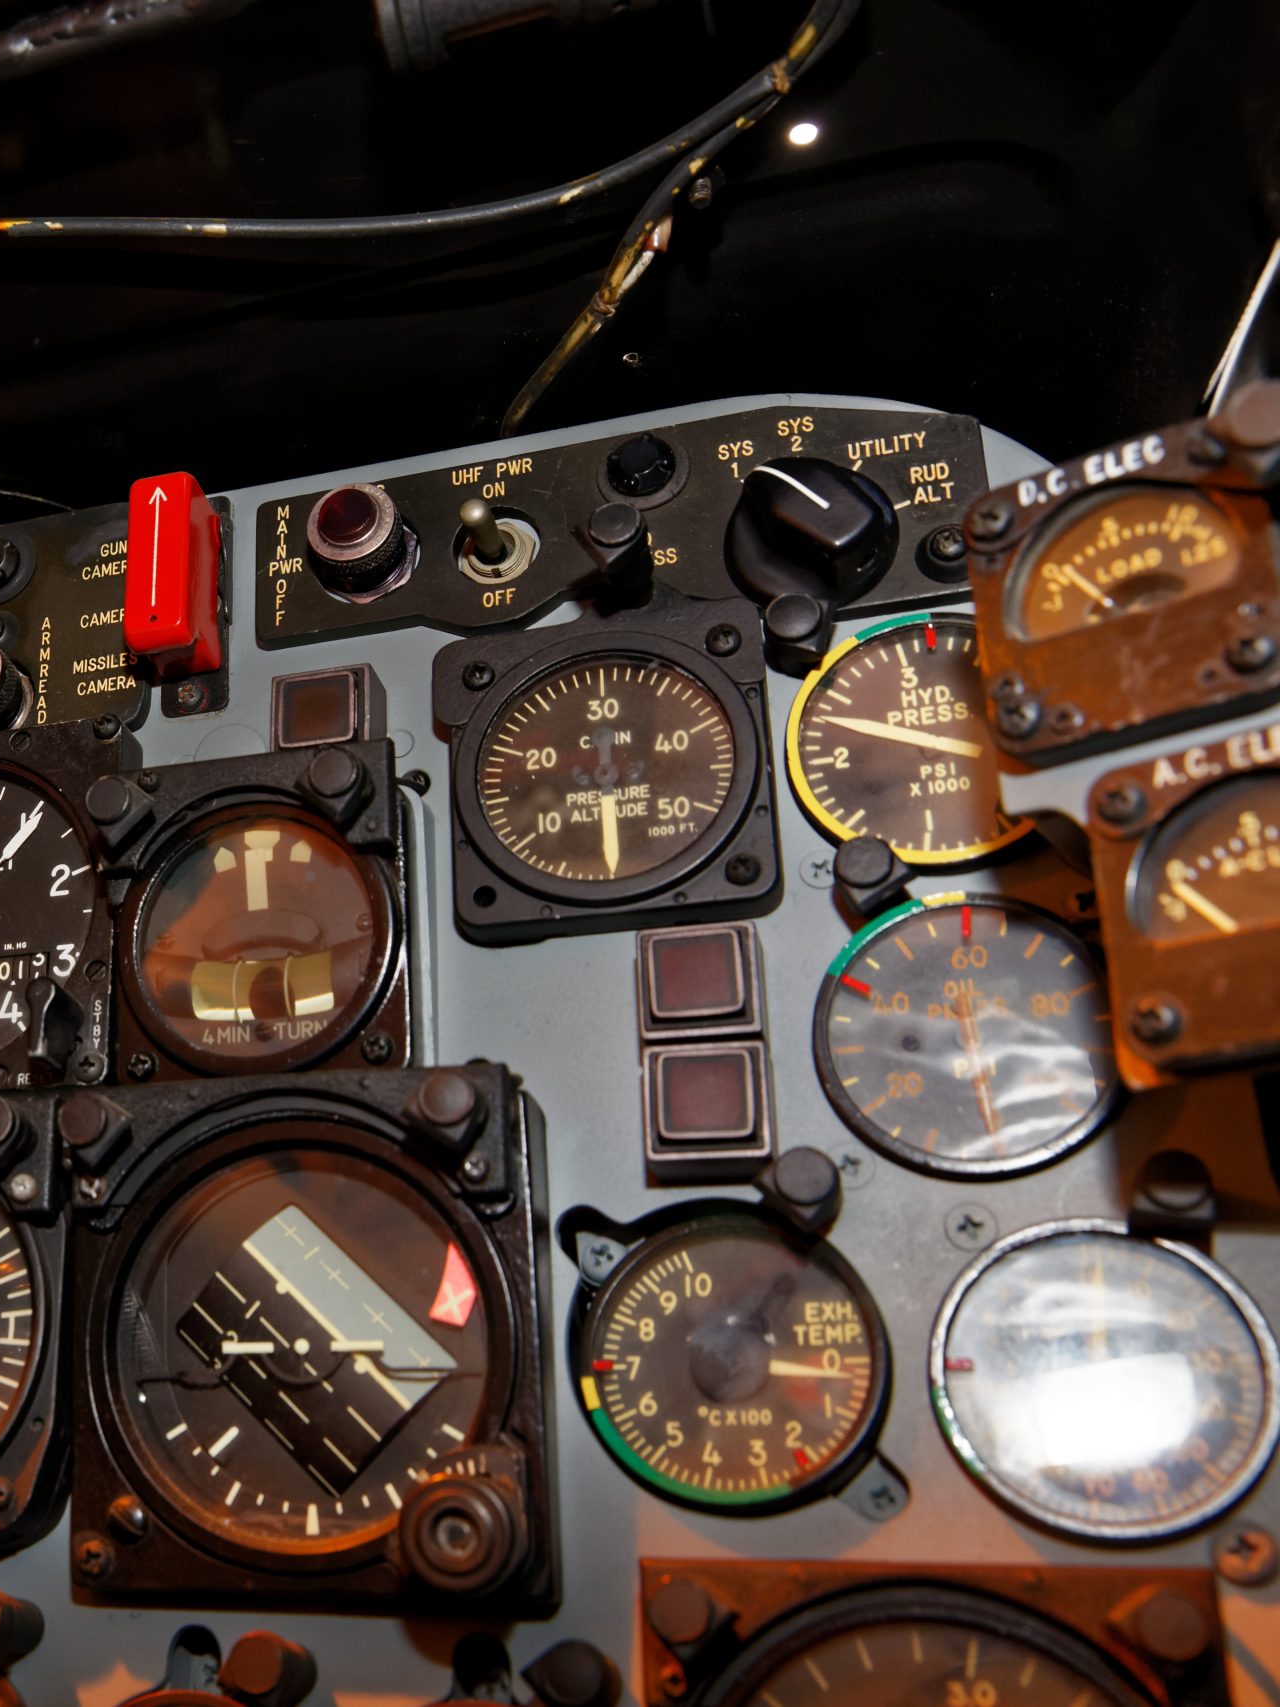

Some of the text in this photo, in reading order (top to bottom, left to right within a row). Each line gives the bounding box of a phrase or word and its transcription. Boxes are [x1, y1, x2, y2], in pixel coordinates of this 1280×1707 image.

[778, 416, 814, 437] SYS
[718, 440, 753, 461] SYS
[791, 437, 802, 452] 2
[848, 431, 926, 460] UTILITY
[731, 463, 739, 479] 1
[1083, 435, 1166, 485] ELEC
[452, 458, 533, 486] UHF PWR
[910, 462, 950, 485] RUD
[482, 481, 505, 499] ON
[914, 482, 955, 504] ALT
[276, 505, 290, 560] MAIN
[82, 560, 128, 581] CAMER
[269, 558, 303, 578] PWR
[275, 579, 287, 627] OFF
[483, 588, 516, 608] OFF
[80, 608, 125, 629] CAMER
[73, 651, 138, 675] MISSILES
[77, 675, 136, 697] CAMERA
[901, 667, 918, 689] 3
[901, 685, 955, 708] HYD.
[587, 698, 619, 721] 30
[579, 730, 631, 749] CIN
[654, 730, 689, 754] 40
[526, 748, 557, 771] 20
[834, 747, 850, 769] 2
[1152, 746, 1222, 790] A.C.
[920, 761, 956, 779] PSI
[928, 777, 970, 795] 1000
[570, 801, 649, 824] ALTUDE
[657, 796, 690, 819] 50
[537, 811, 562, 834] 10
[648, 824, 698, 838] 1000 FT.
[49, 864, 70, 896] 2
[16, 942, 27, 950] HG
[950, 945, 988, 970] 60
[53, 944, 76, 977] 3
[943, 979, 984, 1000] OIL
[872, 992, 910, 1014] 40
[1030, 992, 1068, 1018] 80
[93, 999, 102, 1049] STBY
[276, 1019, 328, 1041] TURN
[887, 1071, 923, 1098] 20
[684, 1272, 712, 1299] 10
[659, 1290, 677, 1315] 9
[805, 1302, 859, 1324] EXH.
[638, 1317, 655, 1342] 8
[793, 1323, 863, 1346] TEMP.
[626, 1356, 641, 1381] 7
[822, 1348, 841, 1375] 0
[638, 1391, 658, 1417] 6
[824, 1393, 832, 1419] 1
[665, 1422, 684, 1447] 5
[785, 1421, 802, 1448] 2
[702, 1440, 721, 1466] 4
[748, 1439, 767, 1467] 3
